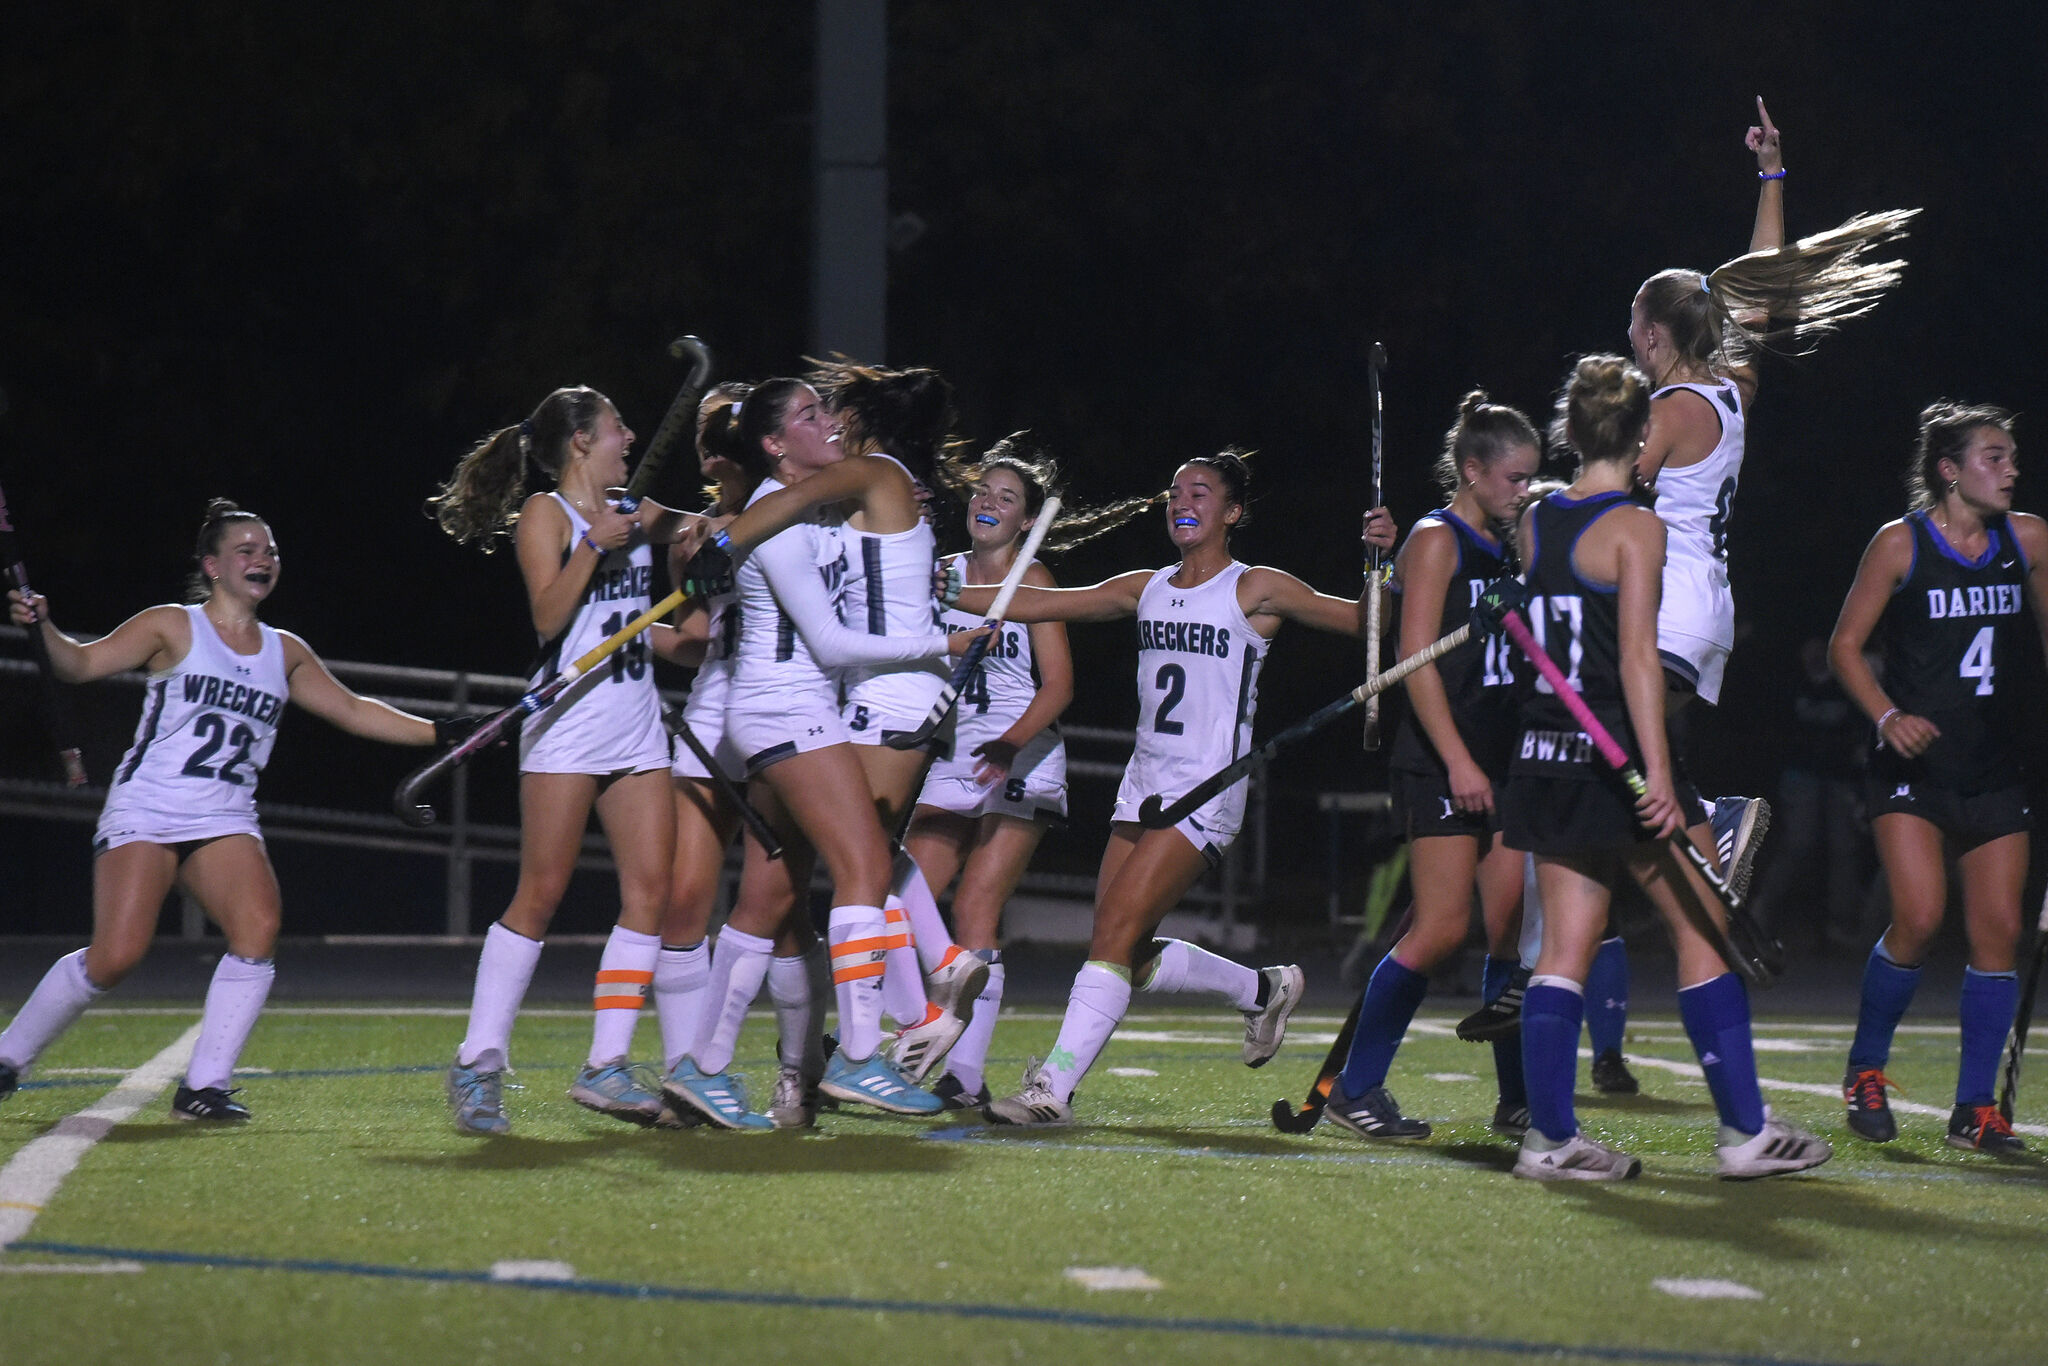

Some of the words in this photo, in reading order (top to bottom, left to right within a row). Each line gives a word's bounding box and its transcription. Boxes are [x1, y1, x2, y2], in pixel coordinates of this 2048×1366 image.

[1959, 626, 1995, 696] 4
[1154, 663, 1187, 736] 2
[182, 713, 256, 785] 22
